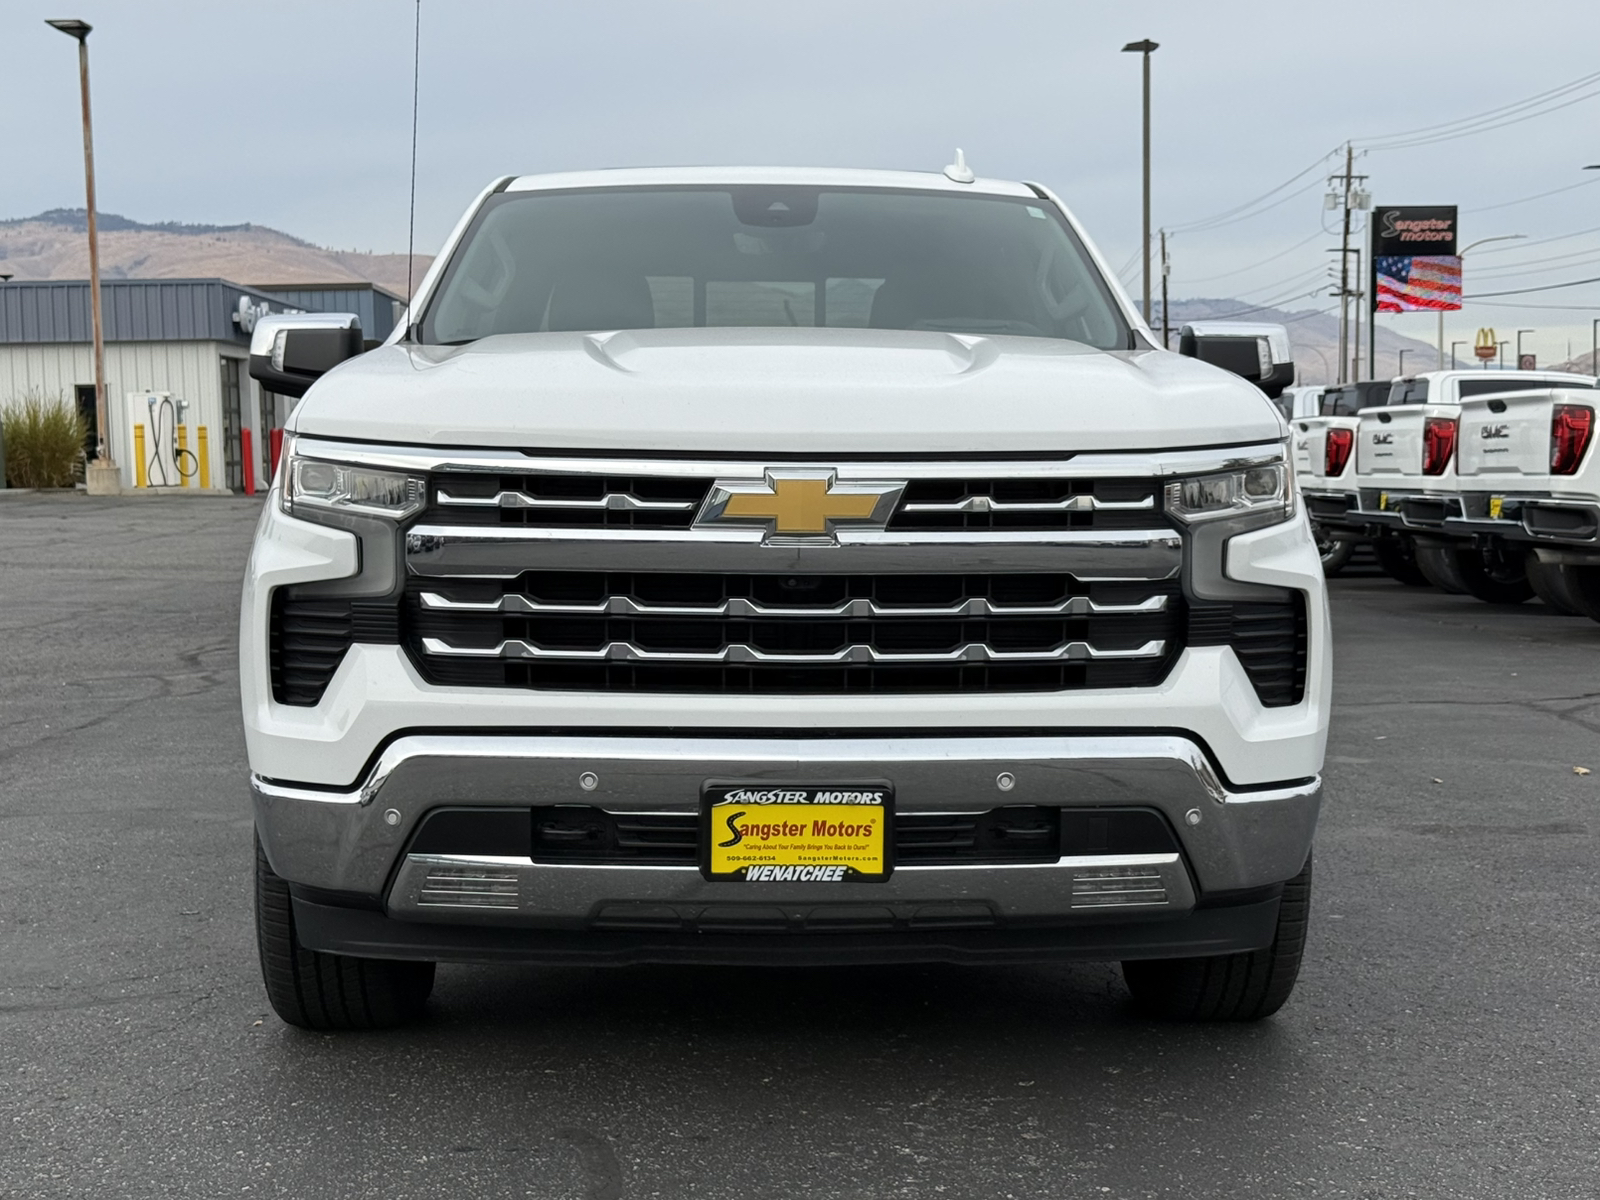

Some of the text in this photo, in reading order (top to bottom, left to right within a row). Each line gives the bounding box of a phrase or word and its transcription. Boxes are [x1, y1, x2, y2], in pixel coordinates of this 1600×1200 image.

[1381, 211, 1452, 238] Sangster
[713, 789, 883, 807] SANGSTER MOTORS
[718, 811, 873, 848] Sangster Motors
[790, 843, 806, 851] Family
[807, 843, 823, 851] Brings
[746, 865, 848, 881] WENATCHEE
